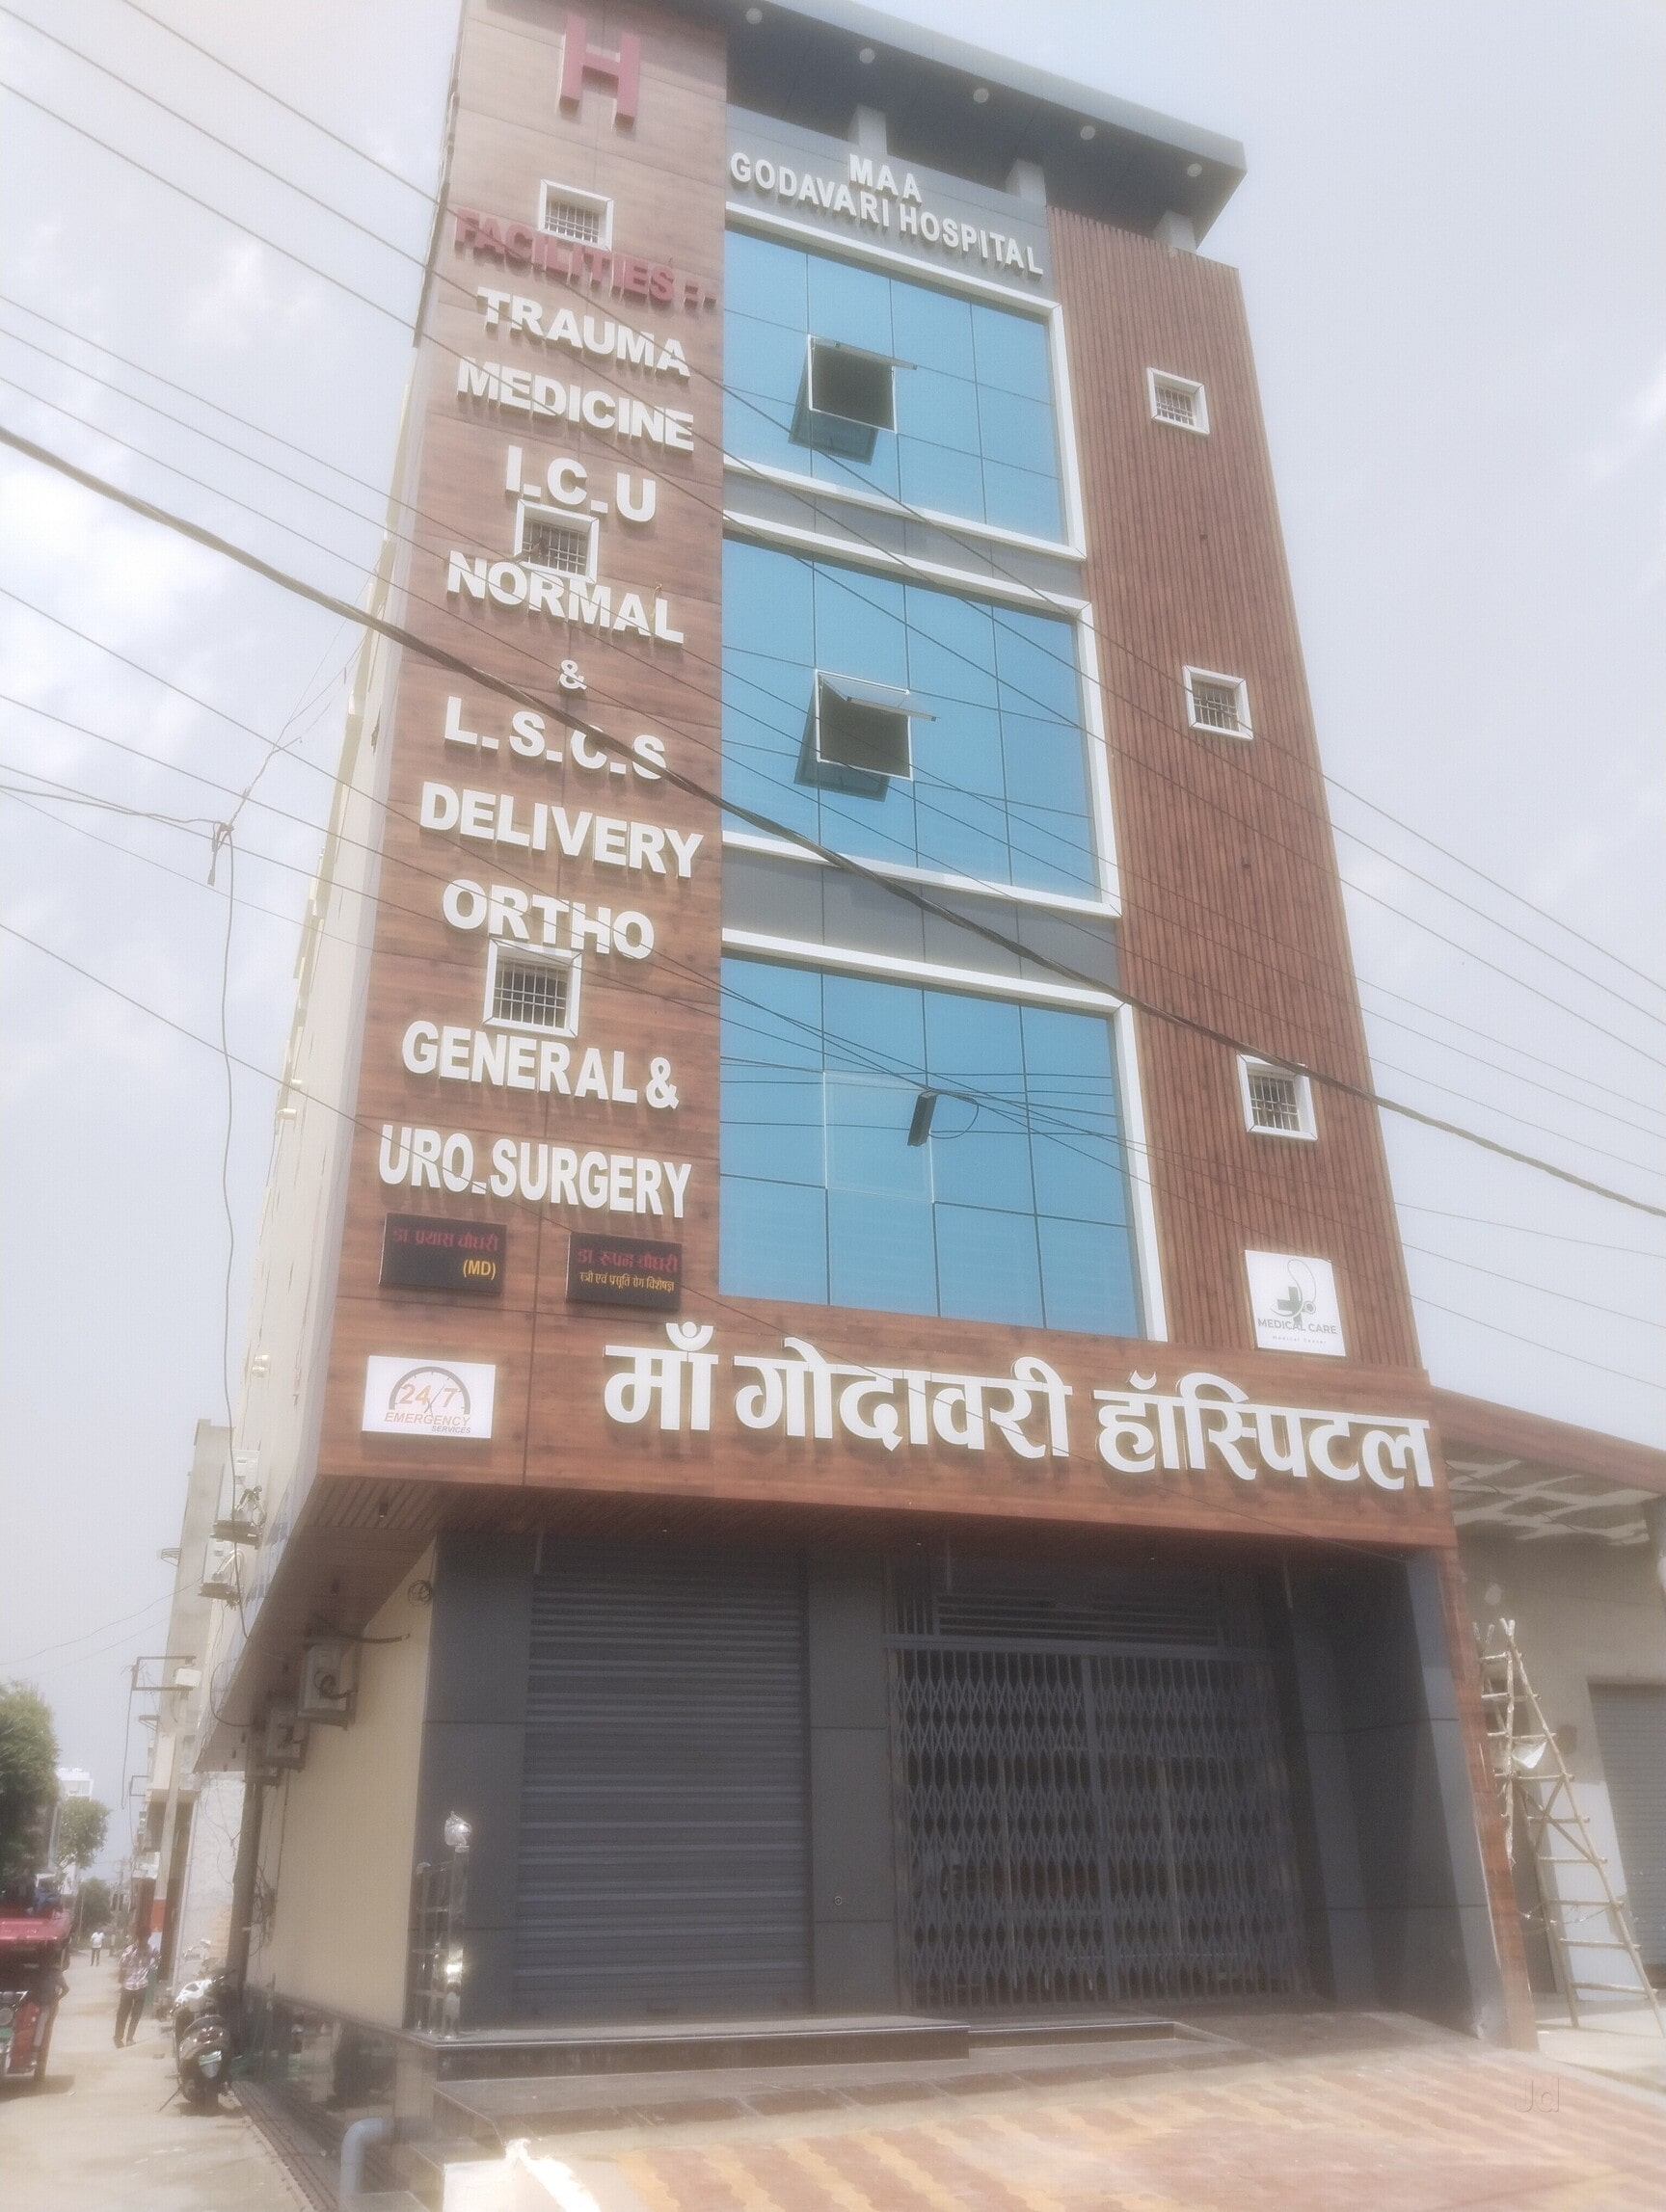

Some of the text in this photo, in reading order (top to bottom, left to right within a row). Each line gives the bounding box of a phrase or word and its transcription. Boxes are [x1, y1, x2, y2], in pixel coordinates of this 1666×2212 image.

[557, 13, 640, 131] H
[730, 151, 1044, 276] GODAVARI HOSPITAL
[848, 153, 923, 204] MAA
[476, 285, 691, 380] TRAUMA
[457, 355, 694, 453] MEDICINE
[446, 549, 685, 645] NORMAL
[559, 659, 587, 690] &
[419, 781, 705, 880] DELIVERY
[442, 878, 656, 960] ORTHO
[402, 1020, 681, 1109] GENERAL &
[463, 1259, 496, 1280] (MD)
[1257, 1318, 1338, 1335] MEDICAL CARE
[384, 1411, 471, 1427] EMERGENCY
[431, 1425, 472, 1435] SERVICES
[604, 1322, 1435, 1491] माँ गोदावरी हॉस्पिटल
